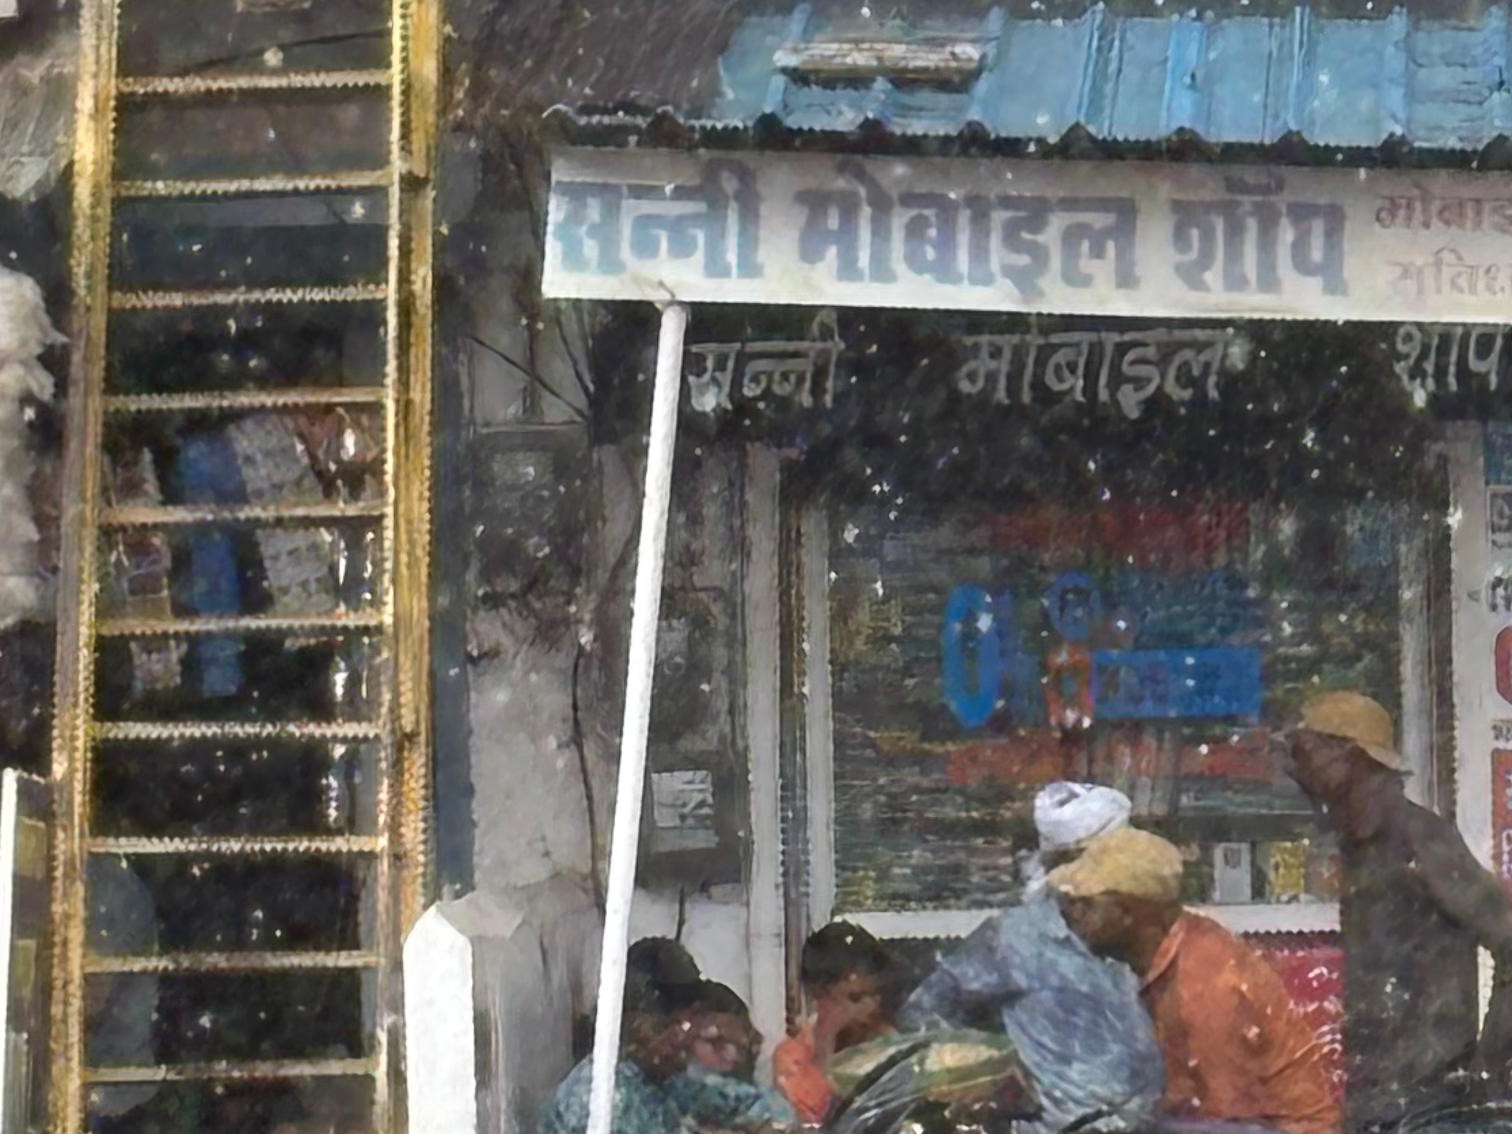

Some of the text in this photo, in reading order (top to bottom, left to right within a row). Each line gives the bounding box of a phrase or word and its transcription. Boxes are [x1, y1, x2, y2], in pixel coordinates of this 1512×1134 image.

[552, 156, 1350, 300] सन्नी मोबाइल शॉप
